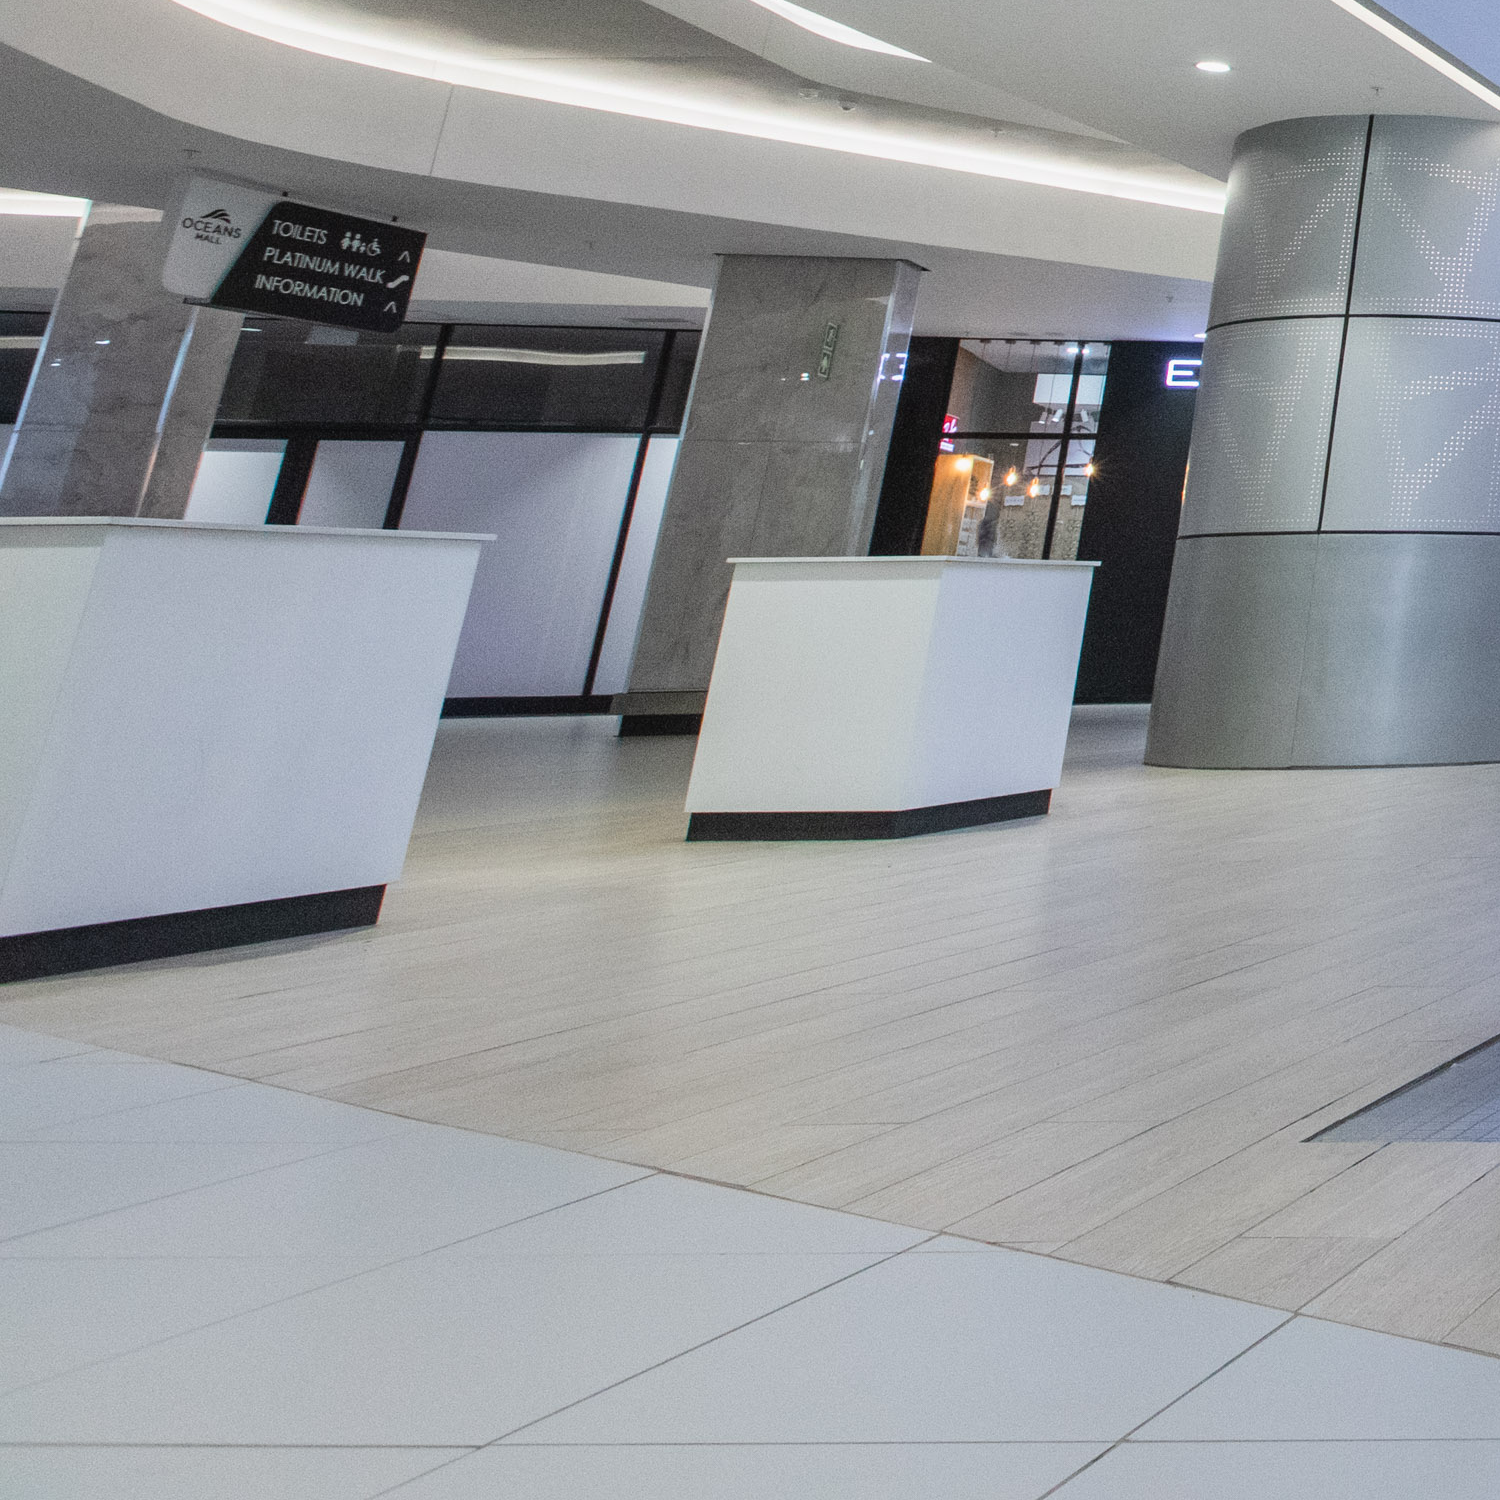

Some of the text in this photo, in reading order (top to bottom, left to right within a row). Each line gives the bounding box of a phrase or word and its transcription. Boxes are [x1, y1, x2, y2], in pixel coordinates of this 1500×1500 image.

[182, 217, 242, 239] OCEANS
[195, 233, 222, 245] MALL
[272, 219, 328, 245] TOILETS
[263, 247, 387, 285] PLATINUM WALK
[254, 274, 365, 308] INFORMATION
